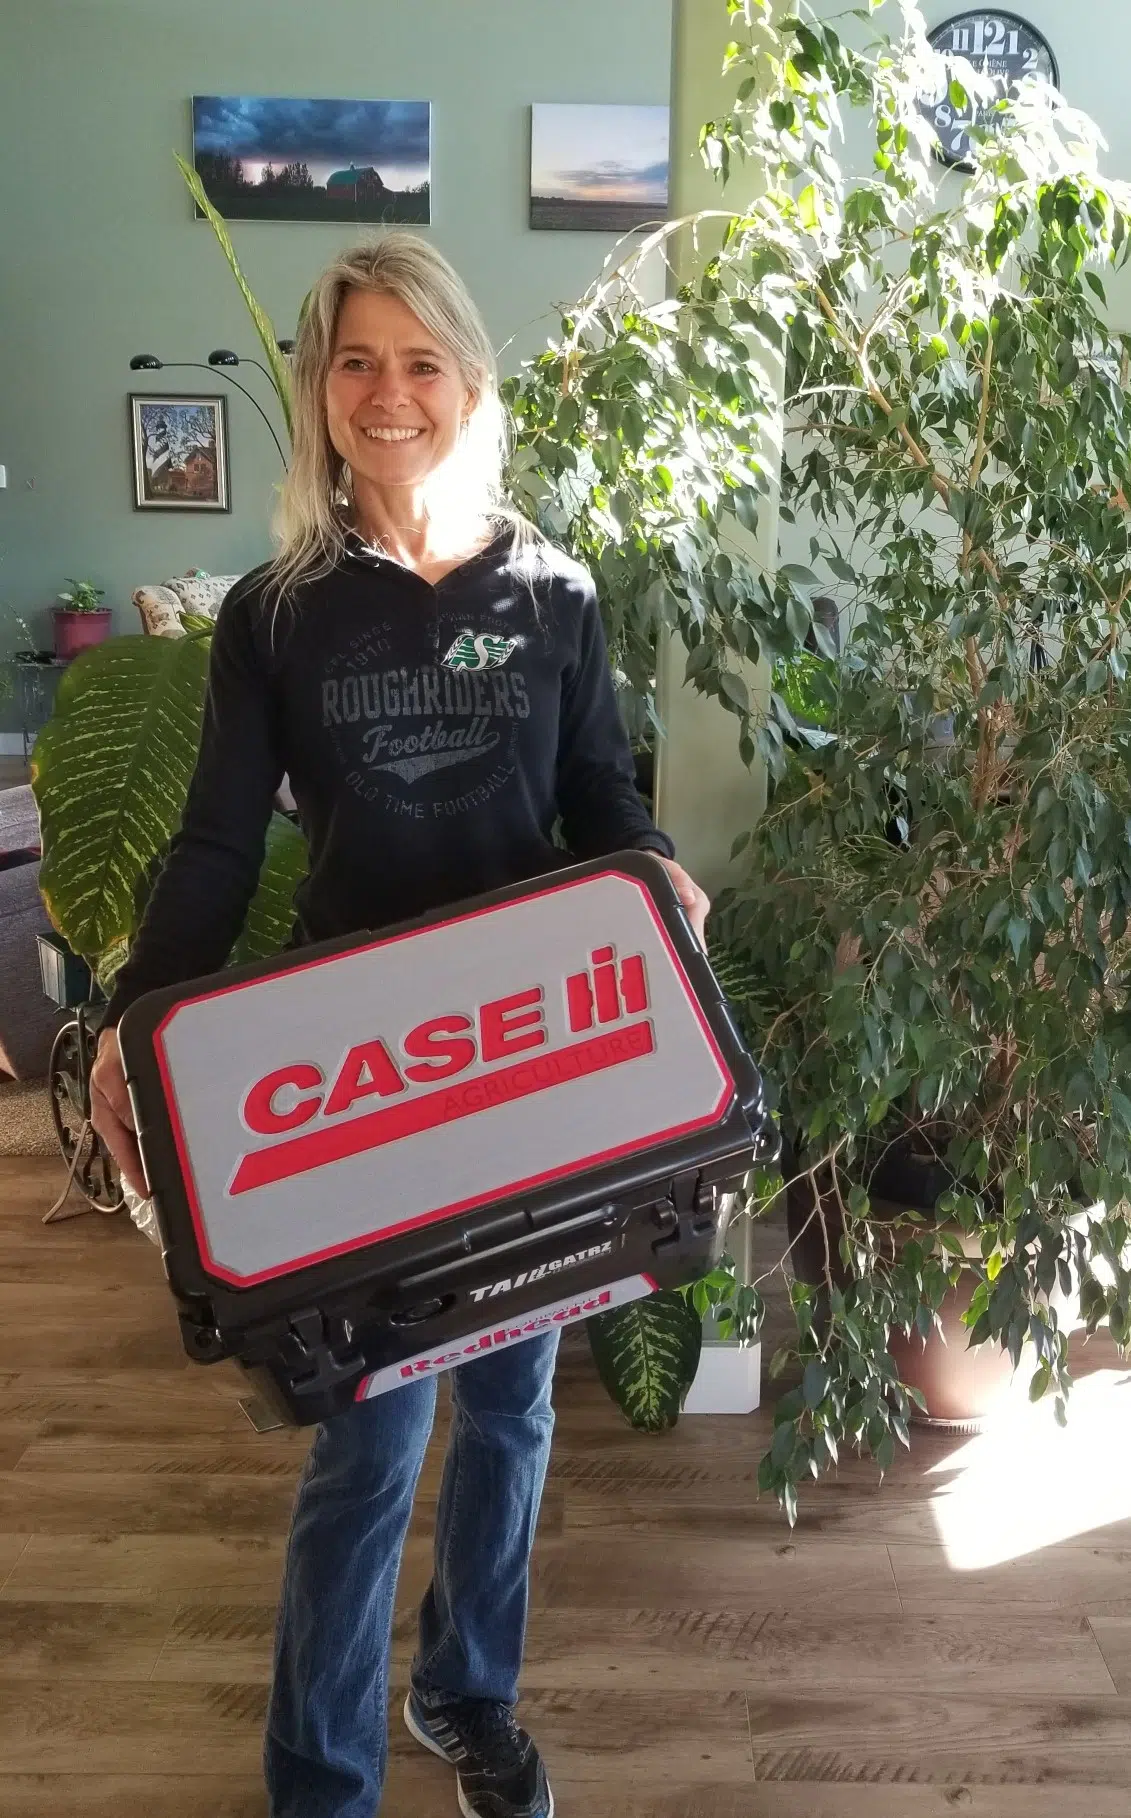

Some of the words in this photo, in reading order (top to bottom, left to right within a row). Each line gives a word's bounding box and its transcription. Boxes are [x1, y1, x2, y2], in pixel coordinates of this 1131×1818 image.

[952, 28, 969, 51] 11
[970, 20, 1005, 55] 12
[1006, 29, 1020, 54] 1
[1022, 47, 1038, 69] 2
[934, 104, 951, 127] 8
[951, 118, 974, 150] 7
[321, 667, 530, 726] ROUGHRIDERS
[361, 716, 500, 764] Football
[345, 771, 379, 801] OLD
[384, 794, 425, 819] TIME
[433, 764, 517, 818] FOOTBALL
[242, 986, 546, 1136] CASE
[443, 1031, 642, 1120] AGRICULTURE
[399, 1290, 612, 1378] Redhead
